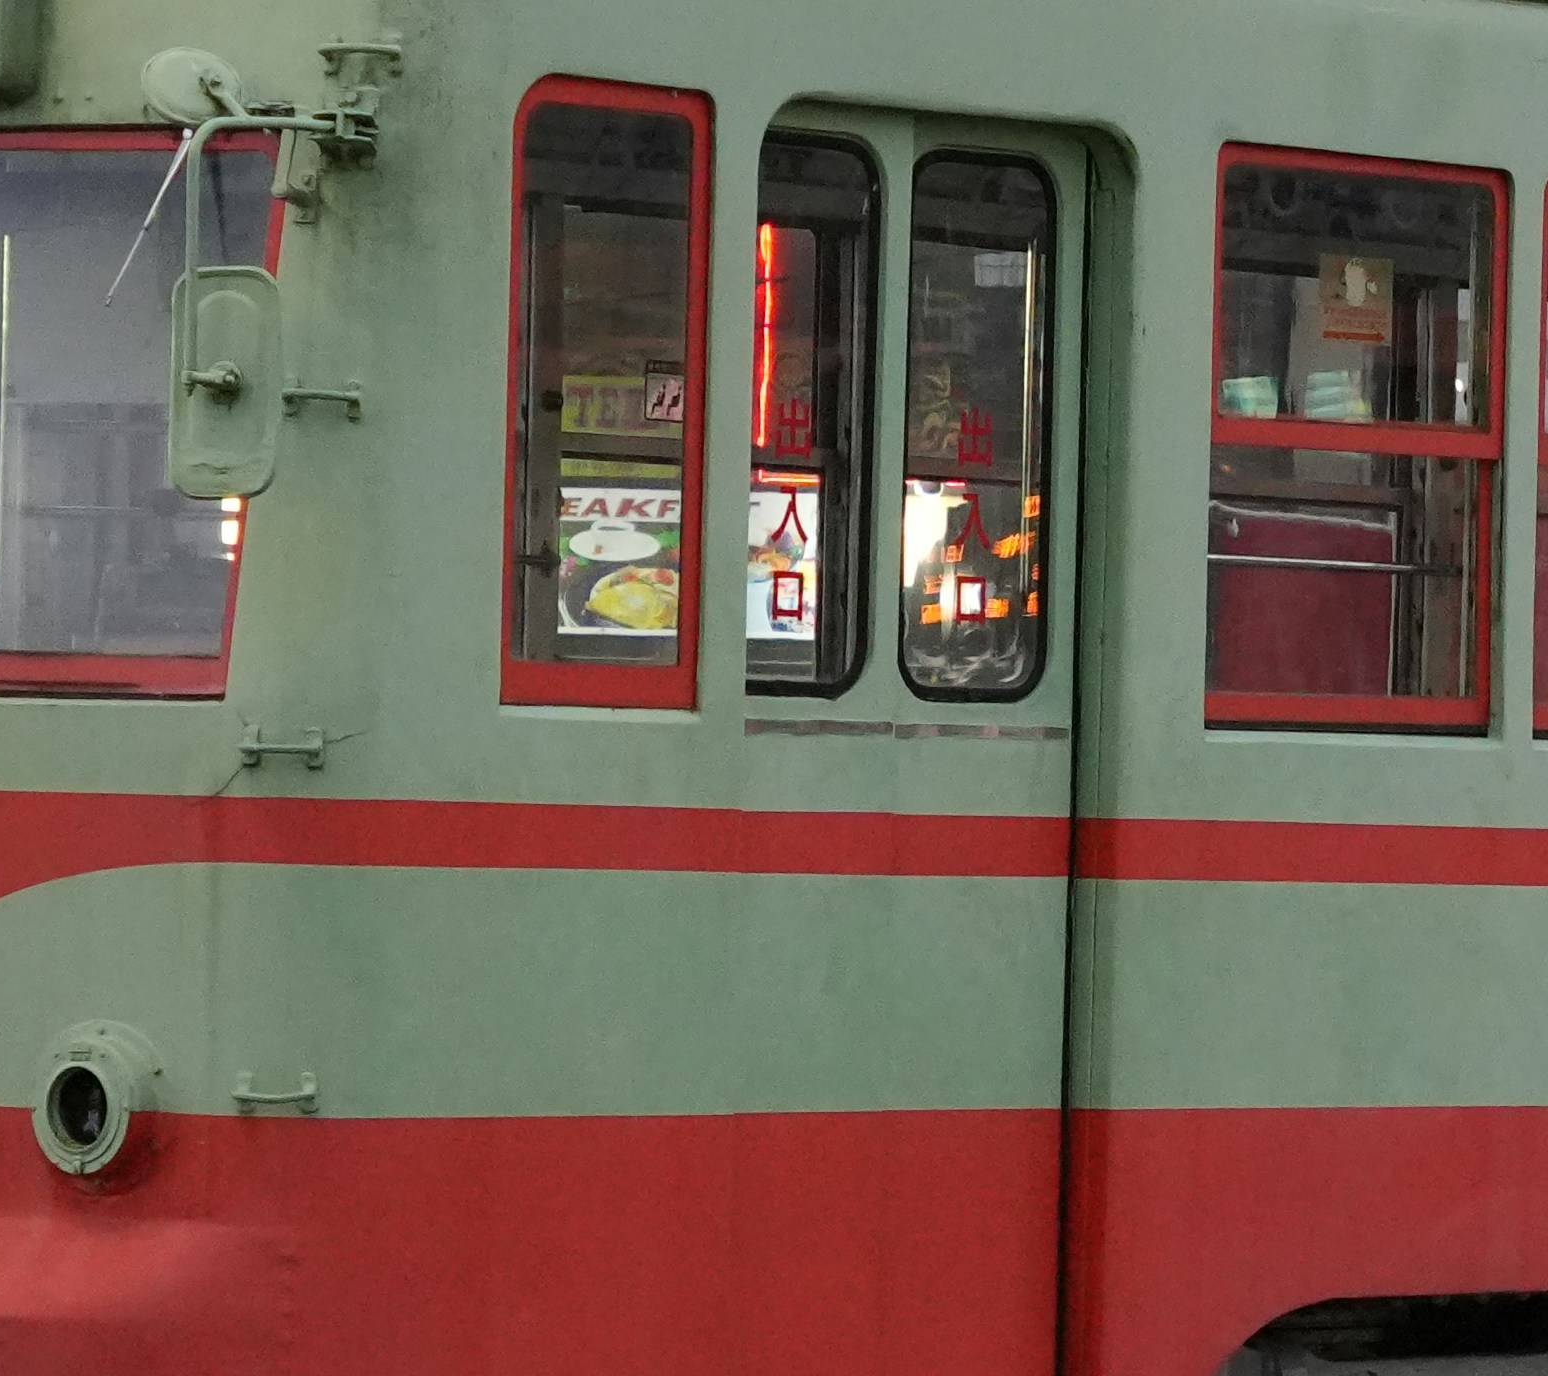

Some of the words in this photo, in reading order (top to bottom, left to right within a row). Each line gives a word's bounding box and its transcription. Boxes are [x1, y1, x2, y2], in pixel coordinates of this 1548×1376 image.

[771, 398, 812, 621] 出入口
[954, 407, 993, 625] 出入口
